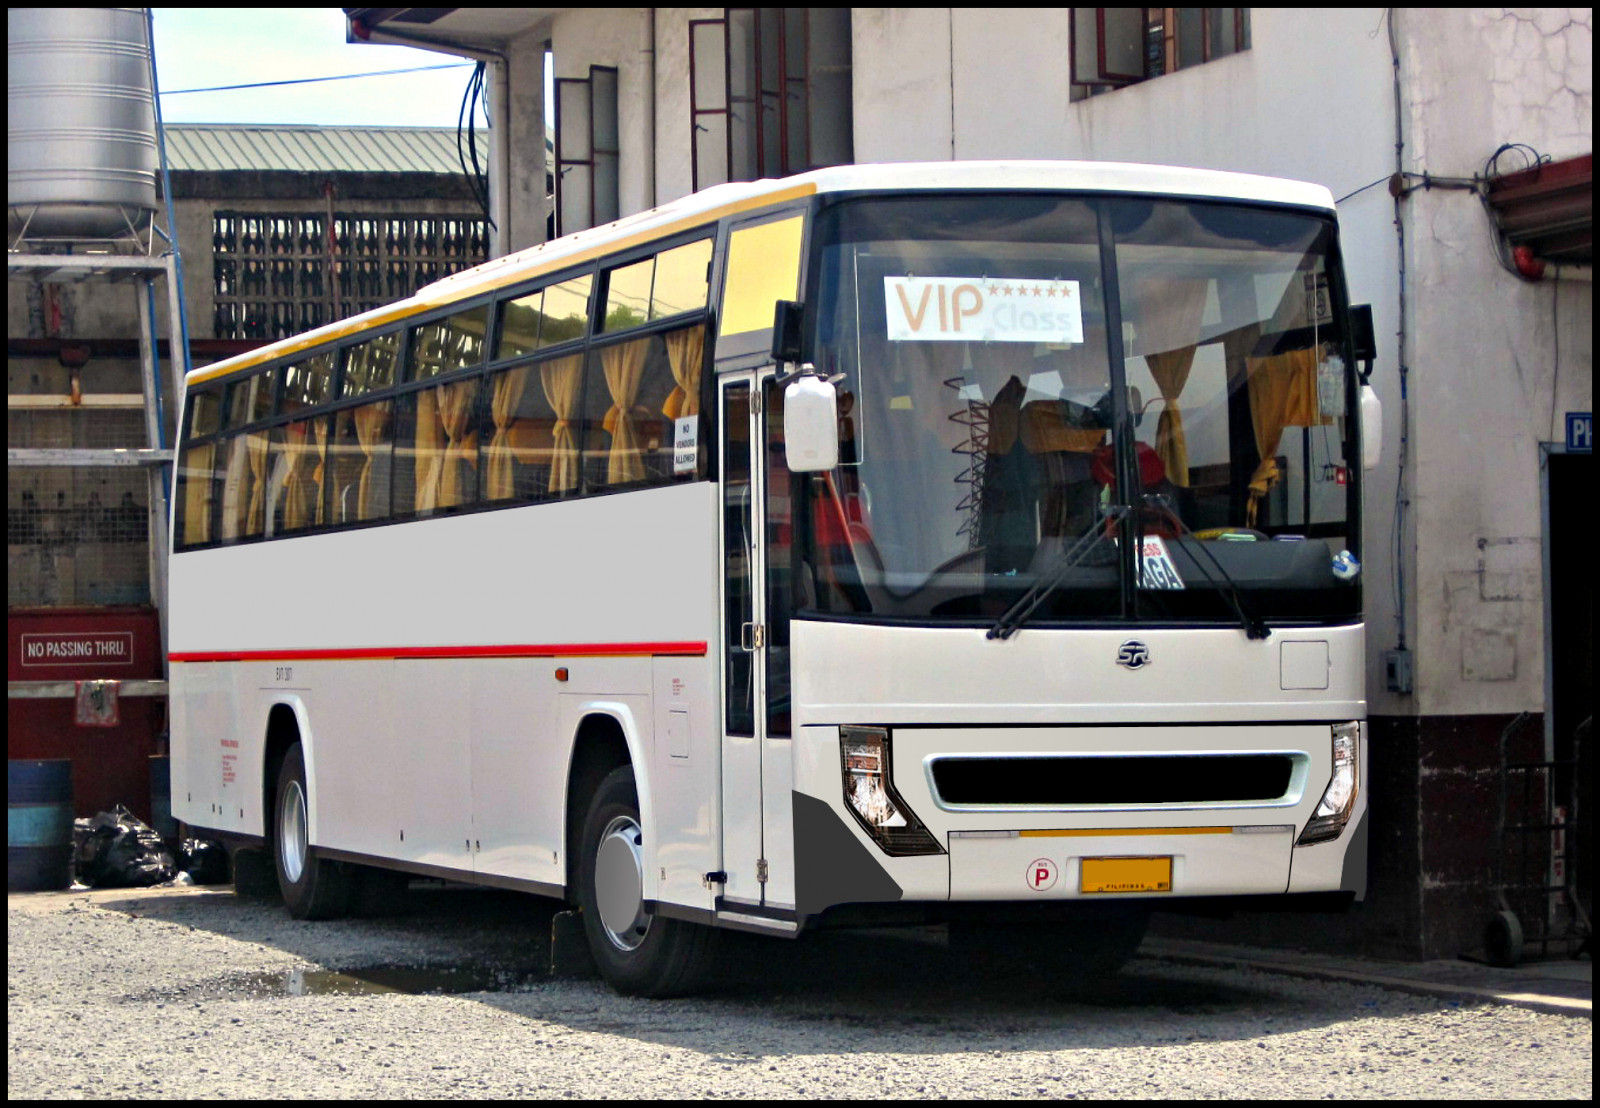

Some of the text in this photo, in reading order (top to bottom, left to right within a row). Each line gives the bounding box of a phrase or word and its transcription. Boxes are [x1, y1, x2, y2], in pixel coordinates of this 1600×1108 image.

[895, 283, 983, 332] VIP
[992, 303, 1072, 332] Class
[682, 424, 690, 434] NO
[676, 439, 695, 449] VENDORS
[675, 453, 695, 465] ALLOWED
[1135, 557, 1183, 590] AGA
[28, 642, 44, 658] NO
[46, 641, 92, 657] PASSING
[1034, 868, 1050, 887] P
